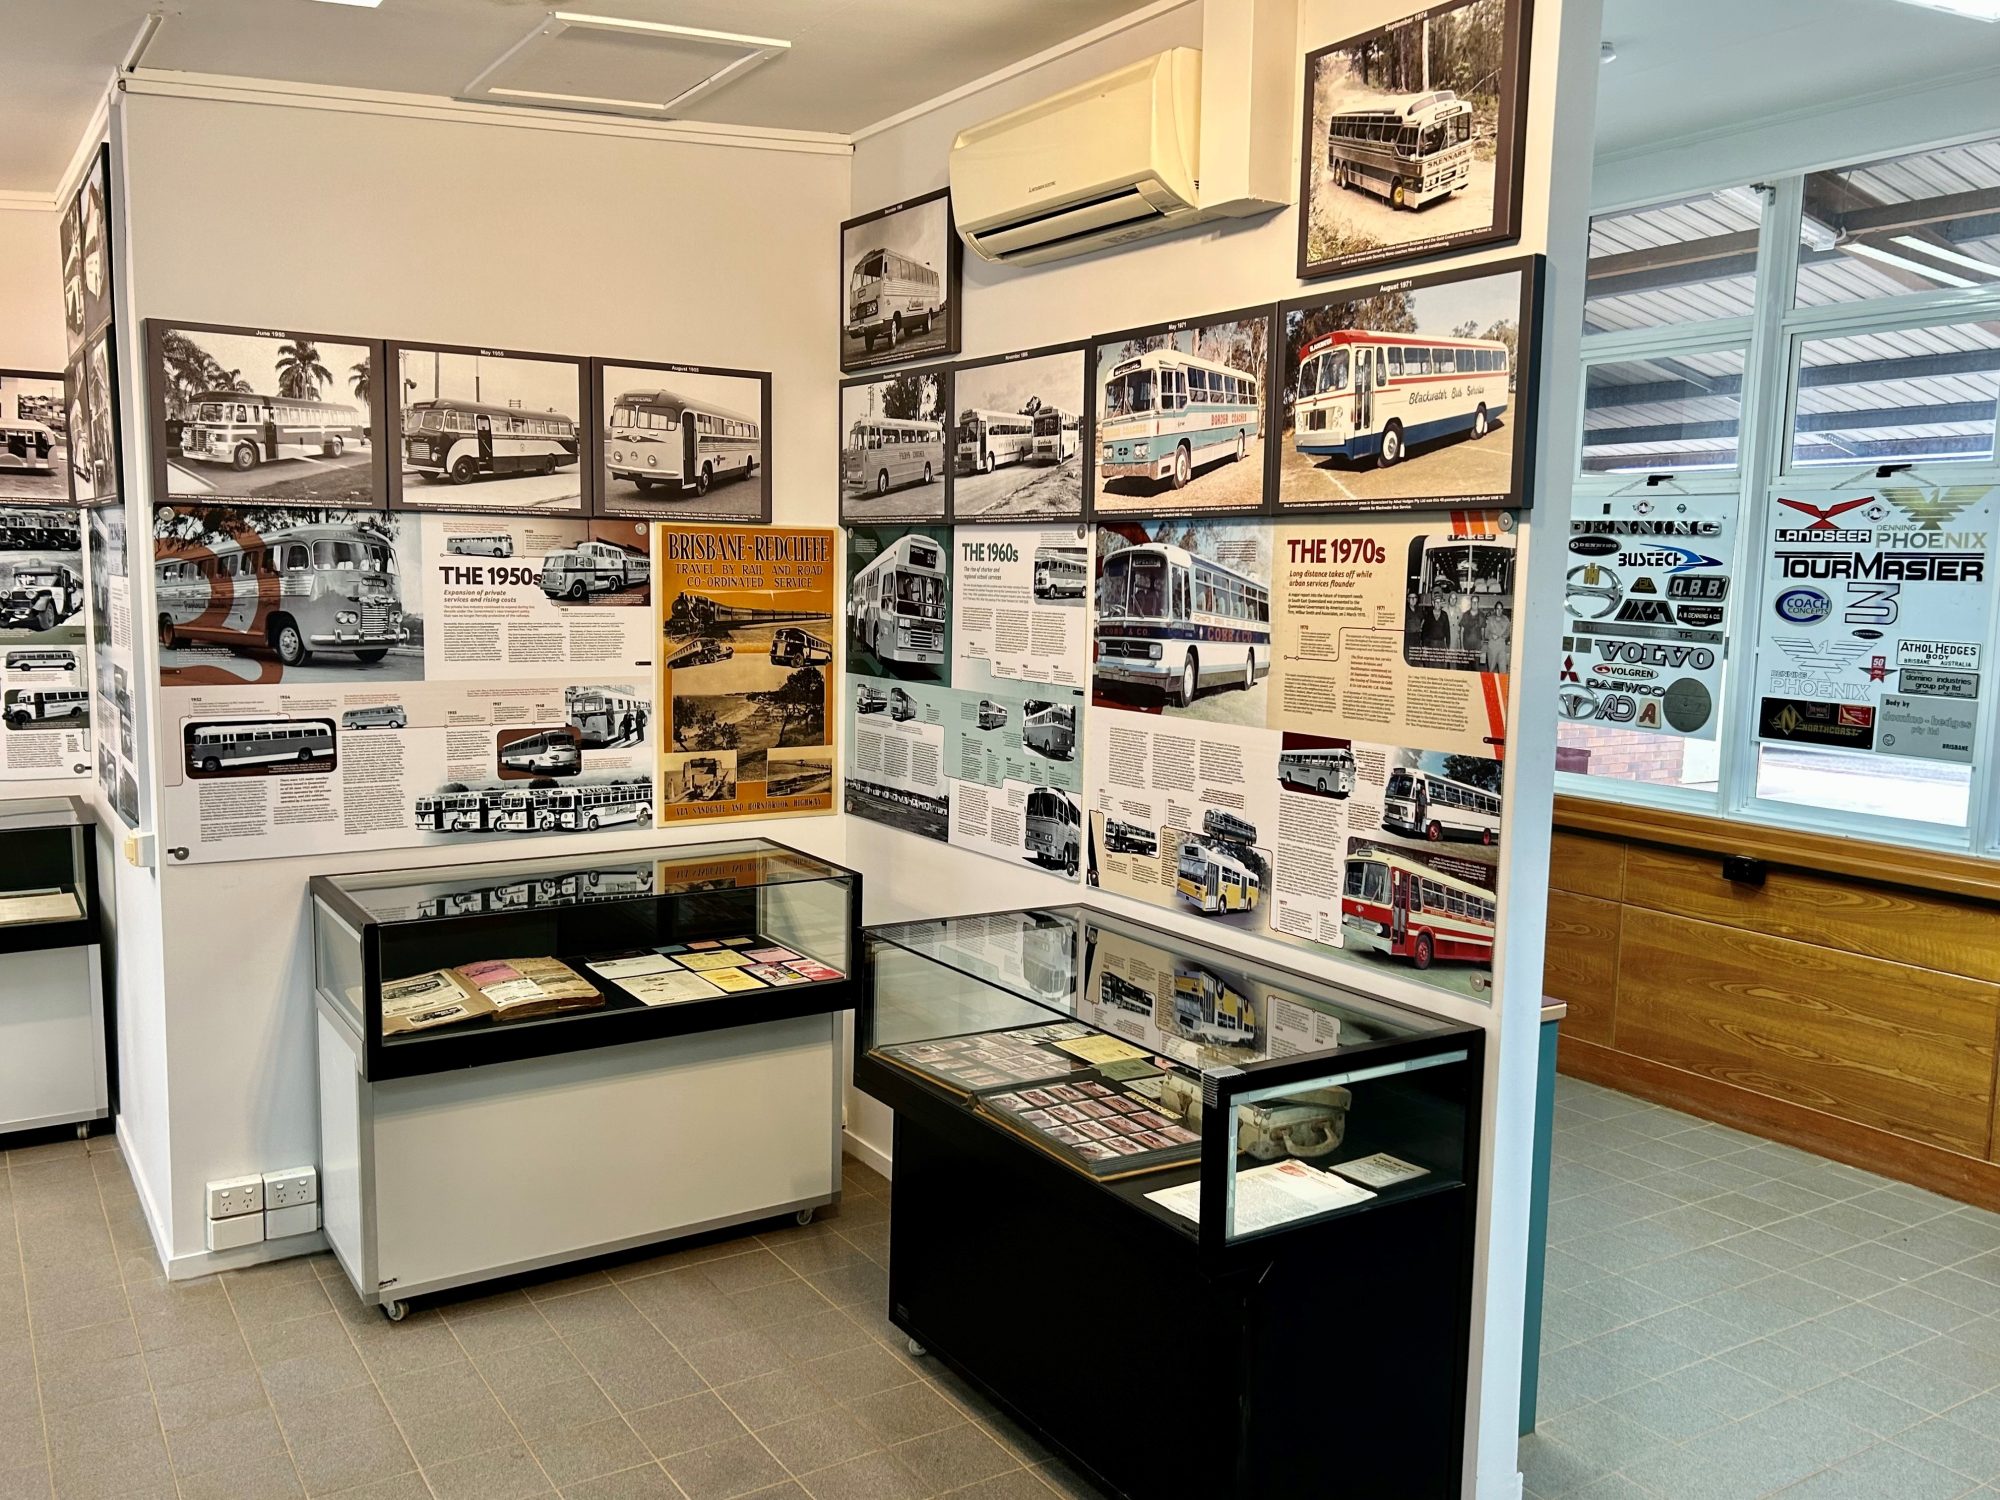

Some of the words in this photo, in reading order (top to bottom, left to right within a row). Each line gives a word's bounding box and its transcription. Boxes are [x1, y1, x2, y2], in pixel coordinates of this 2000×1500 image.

[1385, 17, 1413, 32] September
[1379, 283, 1399, 293] August
[1400, 280, 1412, 289] 1971
[255, 329, 271, 337] June
[671, 365, 688, 373] August
[1408, 389, 1447, 405] Blackwater
[1211, 414, 1229, 426] BORDER
[1775, 530, 1871, 542] LANDSEER
[1875, 531, 1988, 549] PHOENIX
[962, 542, 985, 562] THE
[986, 542, 1019, 563] 1960s
[1287, 538, 1327, 564] THE
[1331, 537, 1386, 564] 1970s
[1618, 552, 1682, 567] BUSTECH
[439, 566, 484, 586] THE
[487, 566, 542, 586] 1950s
[675, 563, 716, 575] TRAVEL
[722, 564, 736, 575] BY
[742, 564, 764, 576] RAIL
[771, 565, 791, 576] AND
[797, 565, 823, 576] ROAD
[1289, 570, 1303, 579] Long
[1304, 569, 1328, 578] distance
[1328, 570, 1345, 578] takes
[1345, 570, 1356, 579] off
[1356, 570, 1373, 578] while
[774, 577, 813, 588] SERVICE
[1289, 579, 1306, 587] urban
[1329, 579, 1356, 589] flounder
[1673, 578, 1722, 597] Q.B.B.
[443, 589, 475, 597] Expansion
[484, 589, 507, 597] private
[482, 596, 500, 604] rising
[1787, 598, 1830, 609] COACH
[1844, 582, 1901, 626] 3
[1787, 607, 1830, 616] CONCEPTS
[1594, 639, 1715, 671] VOLVO
[1900, 641, 1934, 654] ATHOL
[1935, 643, 1977, 656] HEDGES
[1872, 658, 1884, 667] 50
[1610, 664, 1655, 678] VOLGREN
[1905, 674, 1933, 683] domino
[1936, 676, 1972, 686] industries
[1586, 678, 1666, 697] DAEWOO
[1769, 677, 1871, 702] PHOENIX
[1915, 682, 1937, 691] group
[1937, 683, 1951, 692] pty
[1951, 684, 1962, 692] ltd
[1885, 699, 1900, 708] Body
[1902, 700, 1910, 708] by
[1942, 743, 1969, 752] BRISBANE
[676, 807, 689, 817] VIA
[692, 804, 726, 816] SANDGATE
[731, 803, 744, 812] AND
